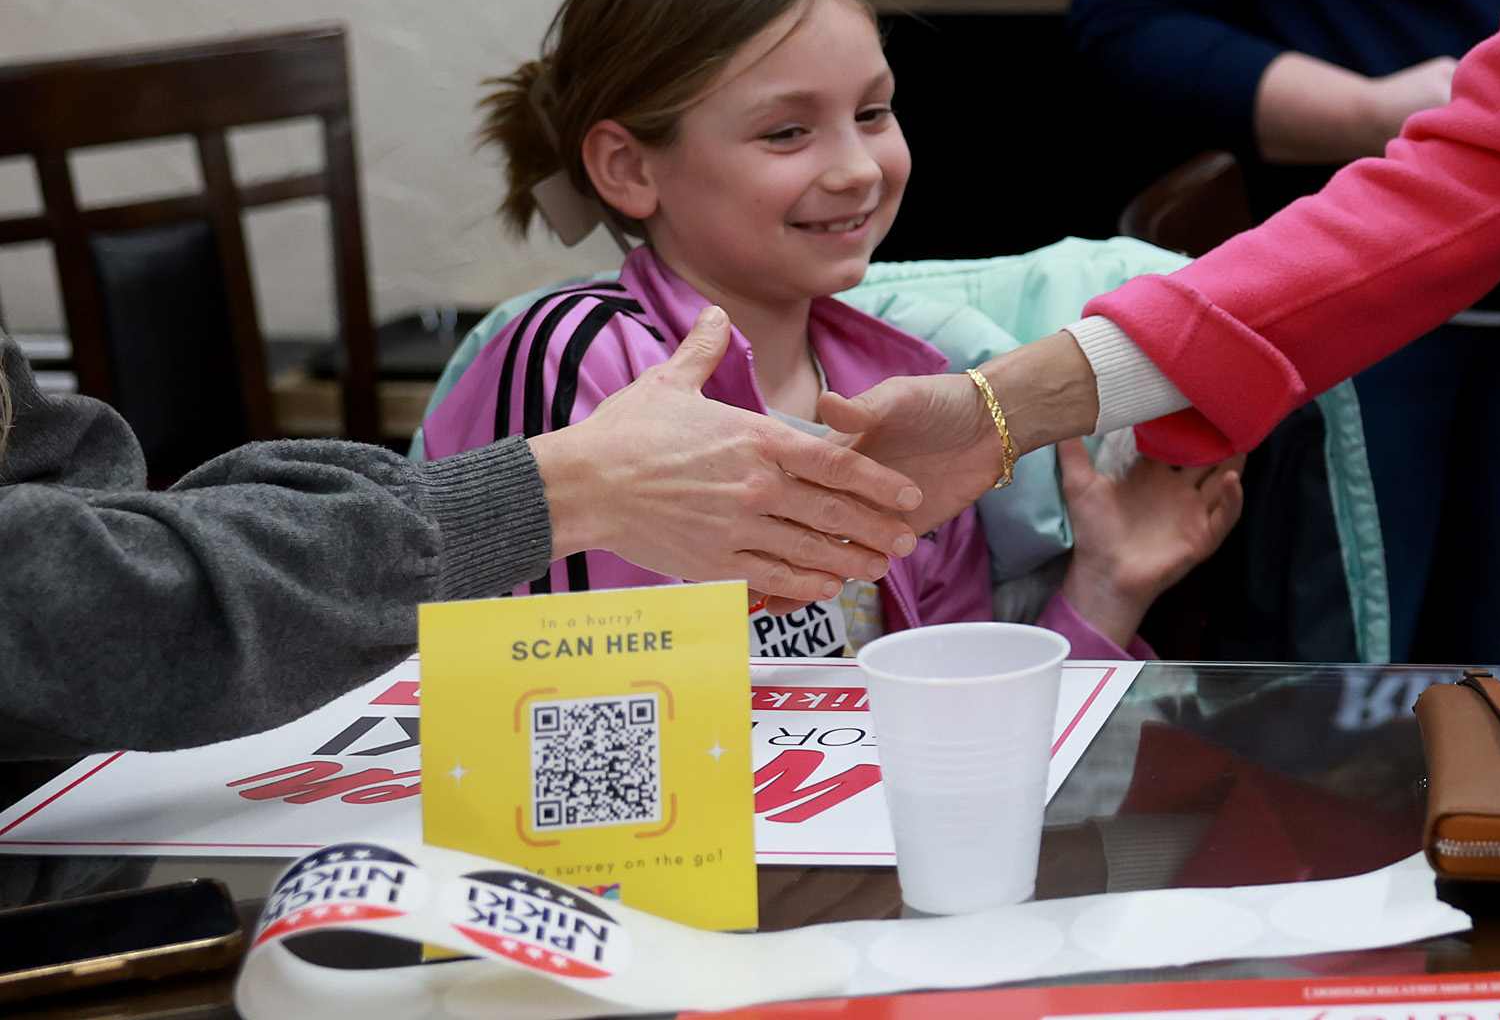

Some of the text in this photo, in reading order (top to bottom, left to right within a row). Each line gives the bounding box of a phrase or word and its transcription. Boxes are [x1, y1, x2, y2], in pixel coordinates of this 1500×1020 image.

[566, 618, 577, 629] a
[586, 609, 643, 628] hurry?
[511, 630, 674, 662] SCAN HERE
[554, 860, 616, 877] survey
[624, 858, 646, 870] on
[654, 853, 685, 867] the
[693, 848, 724, 868] go!
[467, 886, 610, 943] NIKKI
[467, 905, 605, 961] I PICK
